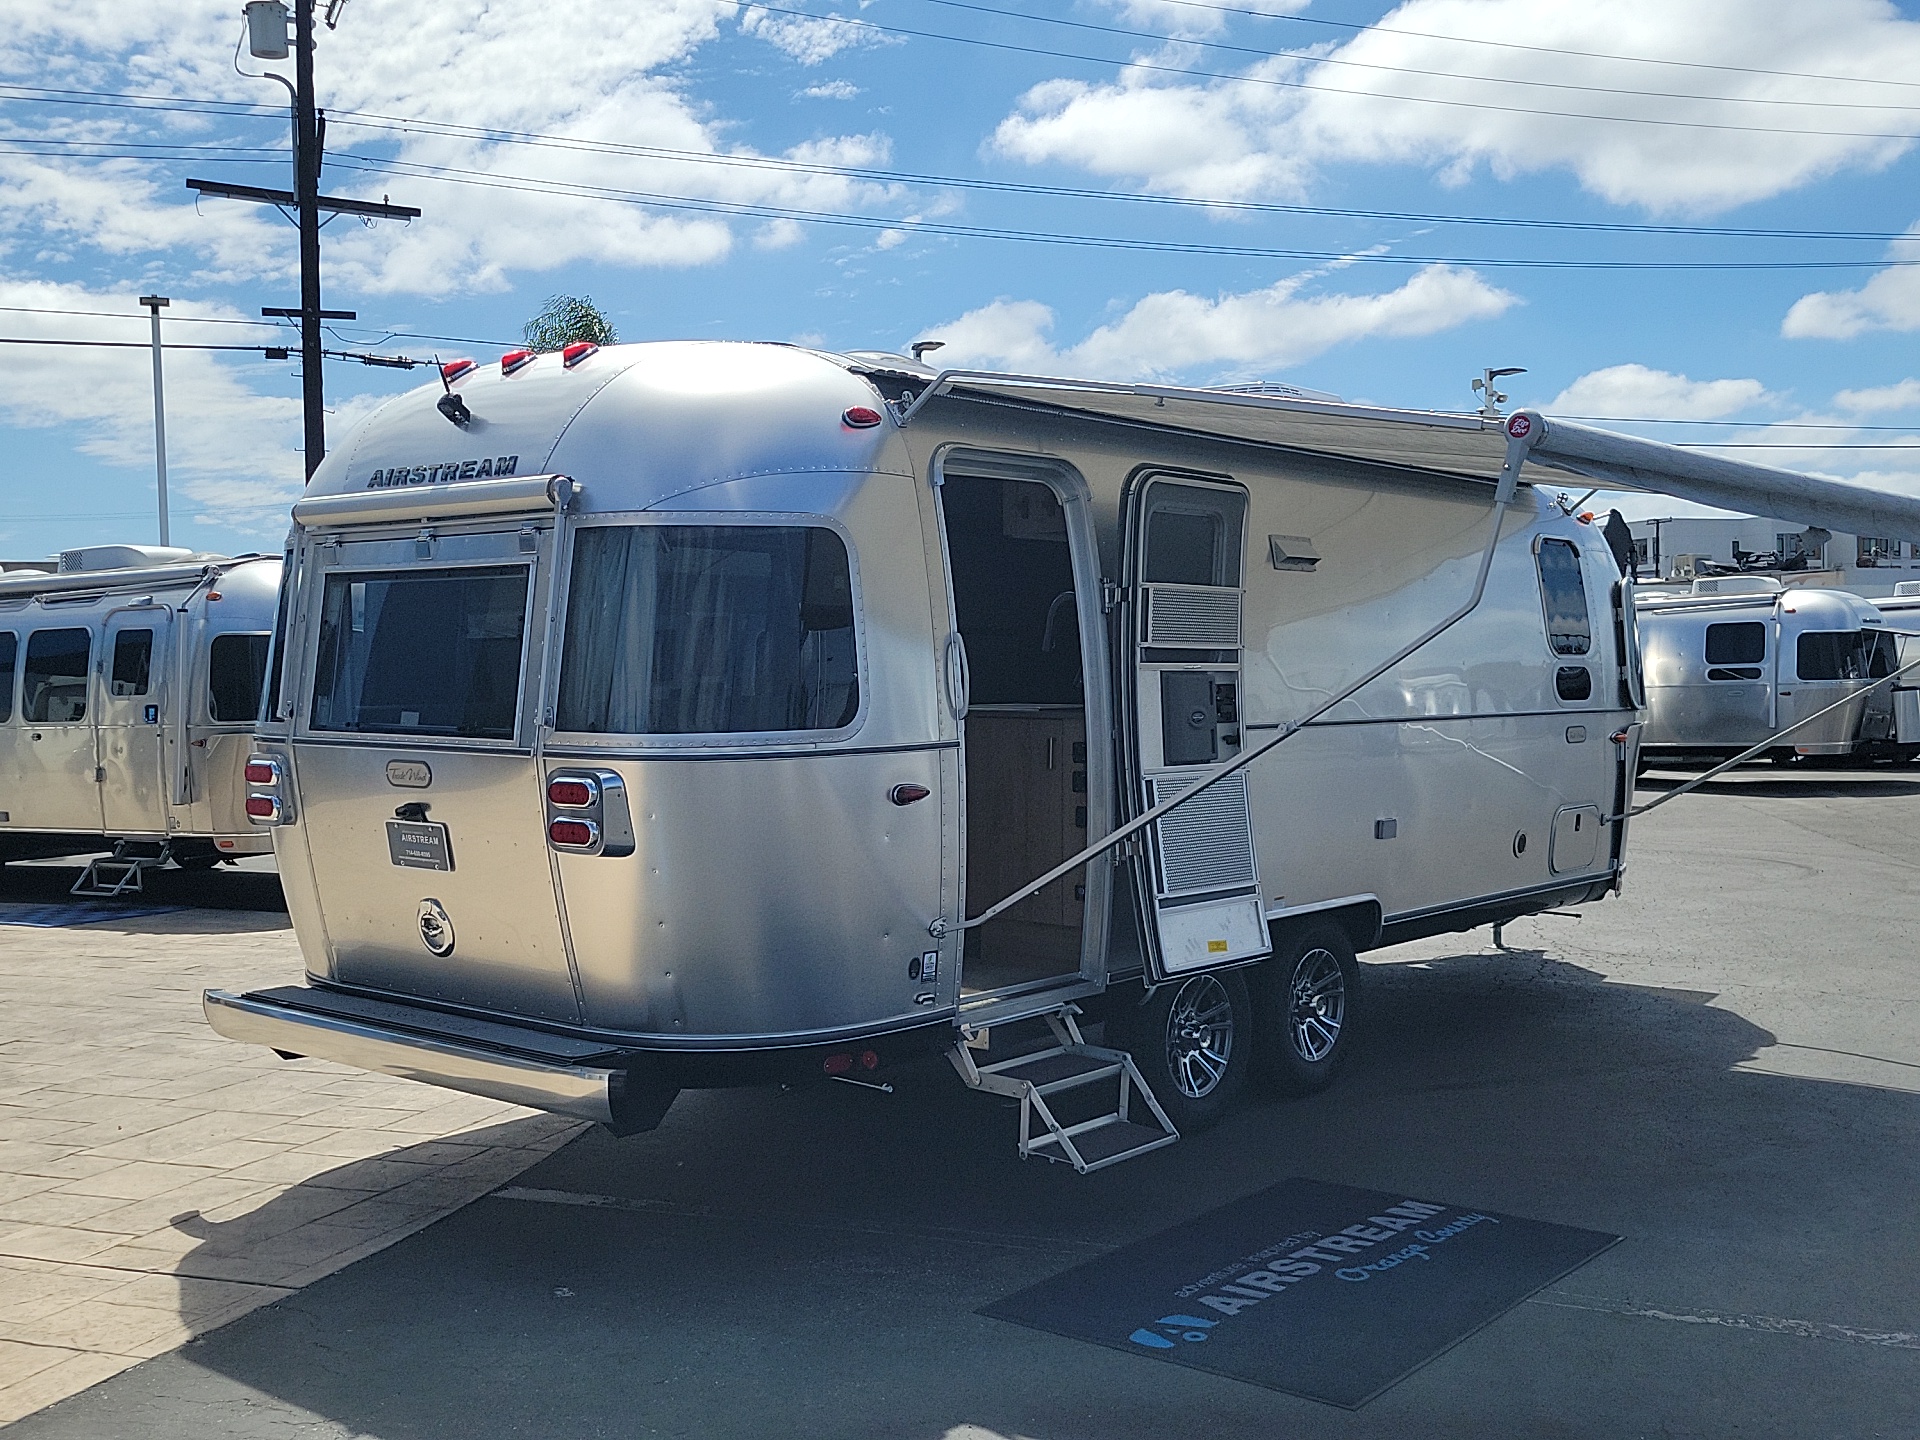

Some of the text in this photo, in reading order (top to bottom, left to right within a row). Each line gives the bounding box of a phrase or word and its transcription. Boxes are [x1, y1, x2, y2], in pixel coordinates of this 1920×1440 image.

[1511, 425, 1528, 434] Dee
[367, 456, 519, 488] AIRSTREAM
[406, 768, 427, 782] Wind
[401, 834, 439, 845] AIRSTREAM
[1198, 1200, 1447, 1316] AIRSTREAM
[1335, 1211, 1500, 1282] Orange County
